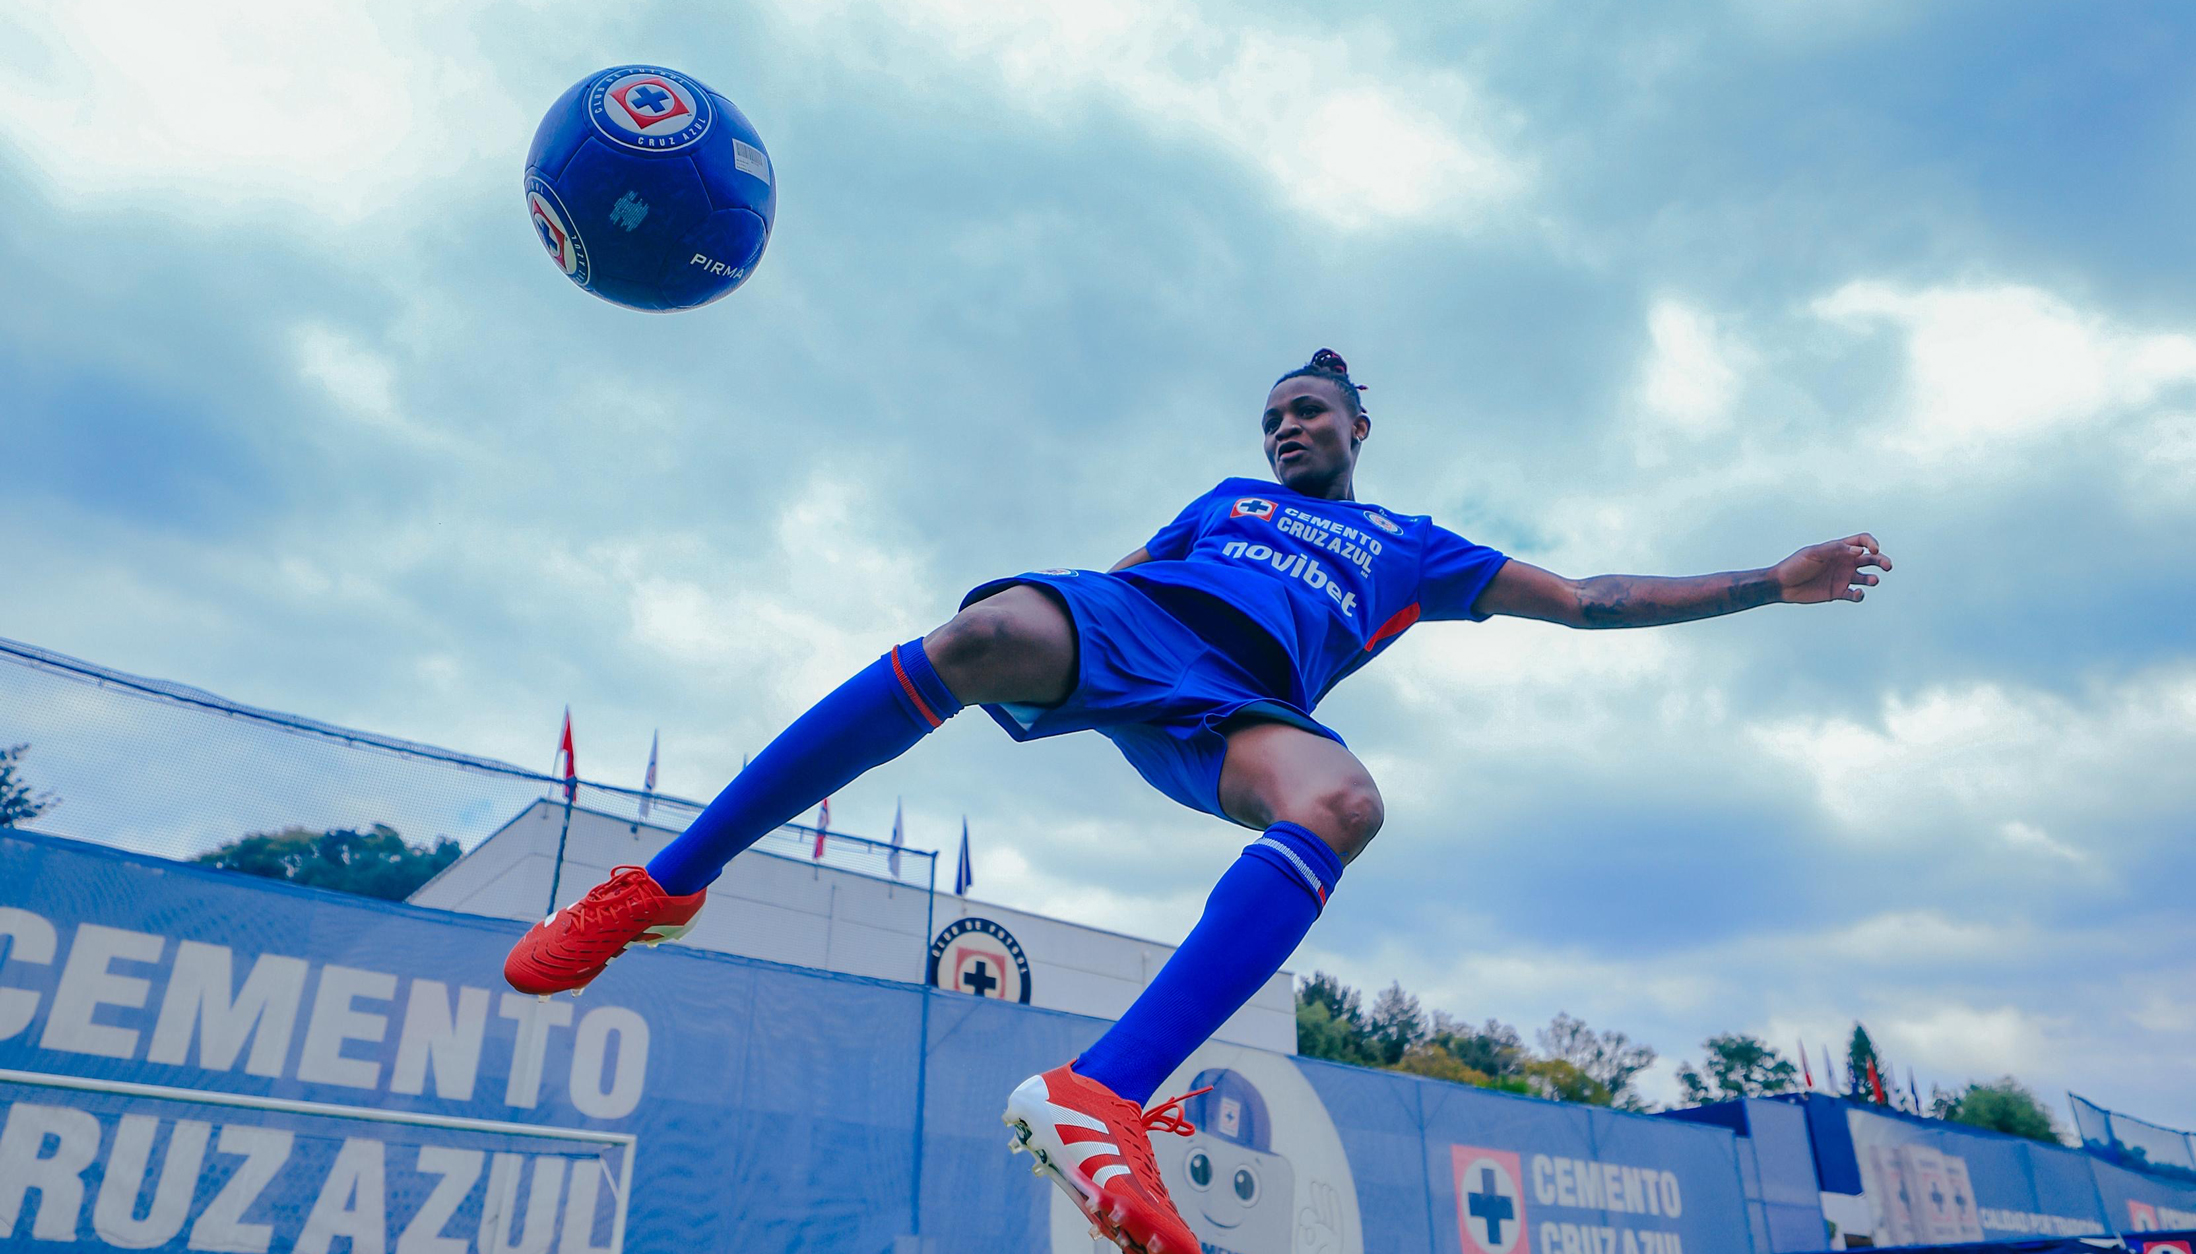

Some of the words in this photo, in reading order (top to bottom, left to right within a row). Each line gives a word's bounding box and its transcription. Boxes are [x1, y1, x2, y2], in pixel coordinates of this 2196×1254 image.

[594, 86, 605, 114] CLUB
[606, 74, 621, 83] DE
[628, 68, 686, 84] FUTBOL
[637, 136, 676, 147] CRUZ
[683, 117, 706, 141] AZUL
[690, 253, 745, 279] PIRMA
[1277, 516, 1329, 547] CRUZ
[1326, 537, 1373, 574] AZUL
[1284, 507, 1383, 556] CEMENTO
[1222, 541, 1357, 617] novibet
[1531, 1153, 1682, 1218] CEMENTO
